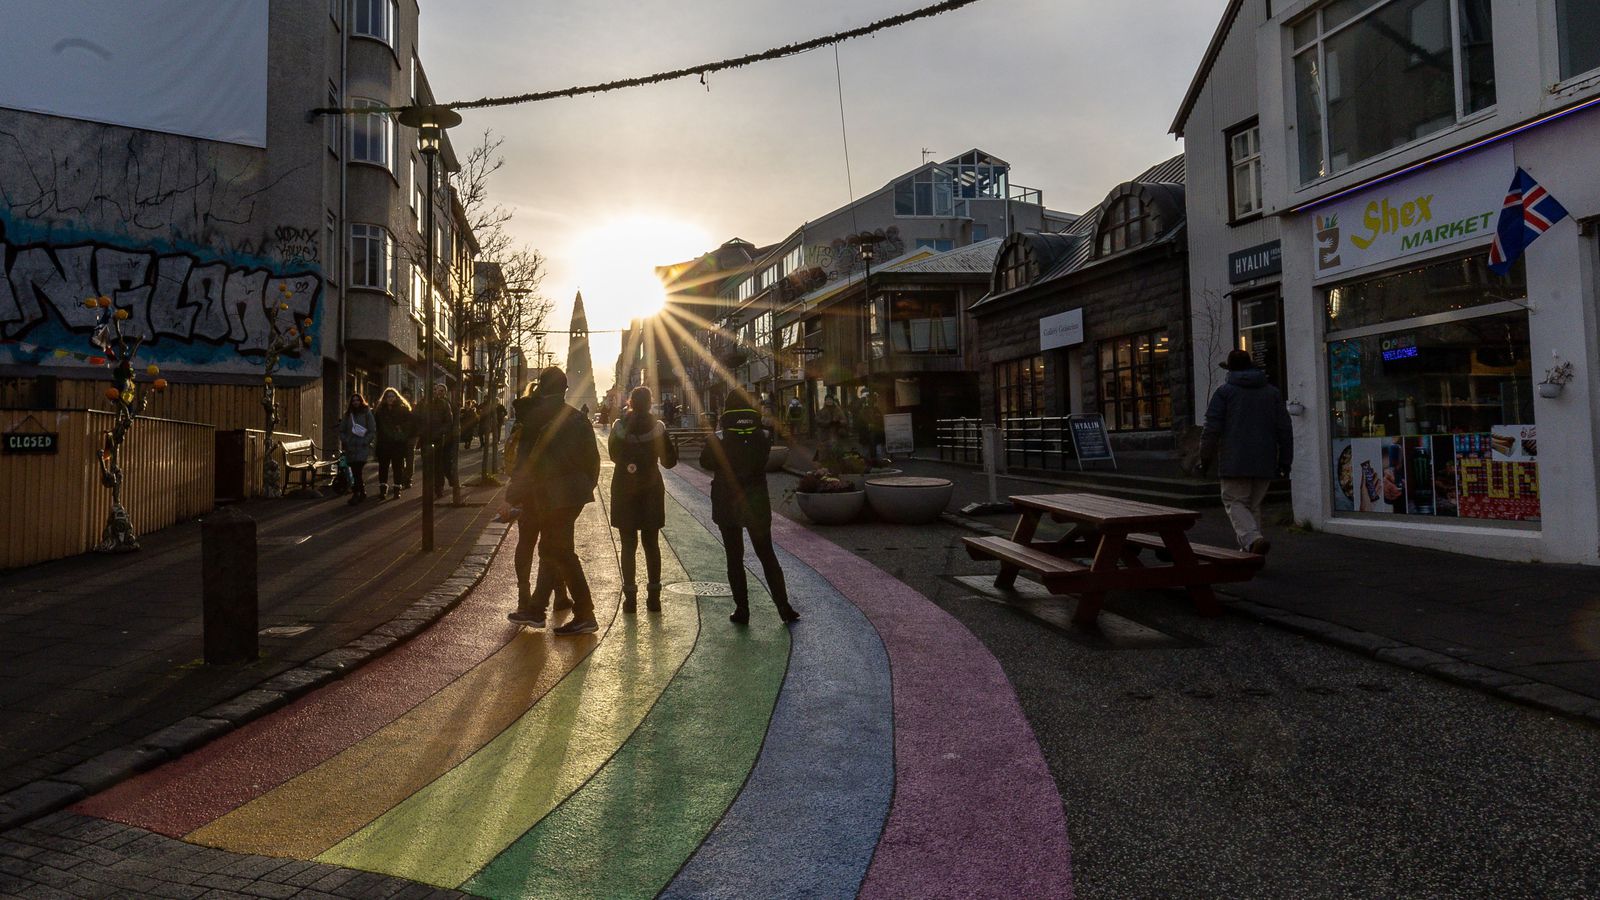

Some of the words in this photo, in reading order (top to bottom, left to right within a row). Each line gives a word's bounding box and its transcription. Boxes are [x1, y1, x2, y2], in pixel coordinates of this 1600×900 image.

[1350, 194, 1434, 250] Shex
[1400, 211, 1494, 251] MARKET
[1235, 251, 1270, 275] HYALIN
[1382, 335, 1416, 350] OPEN
[1074, 421, 1099, 430] HYALIN
[9, 435, 52, 448] CLOSED
